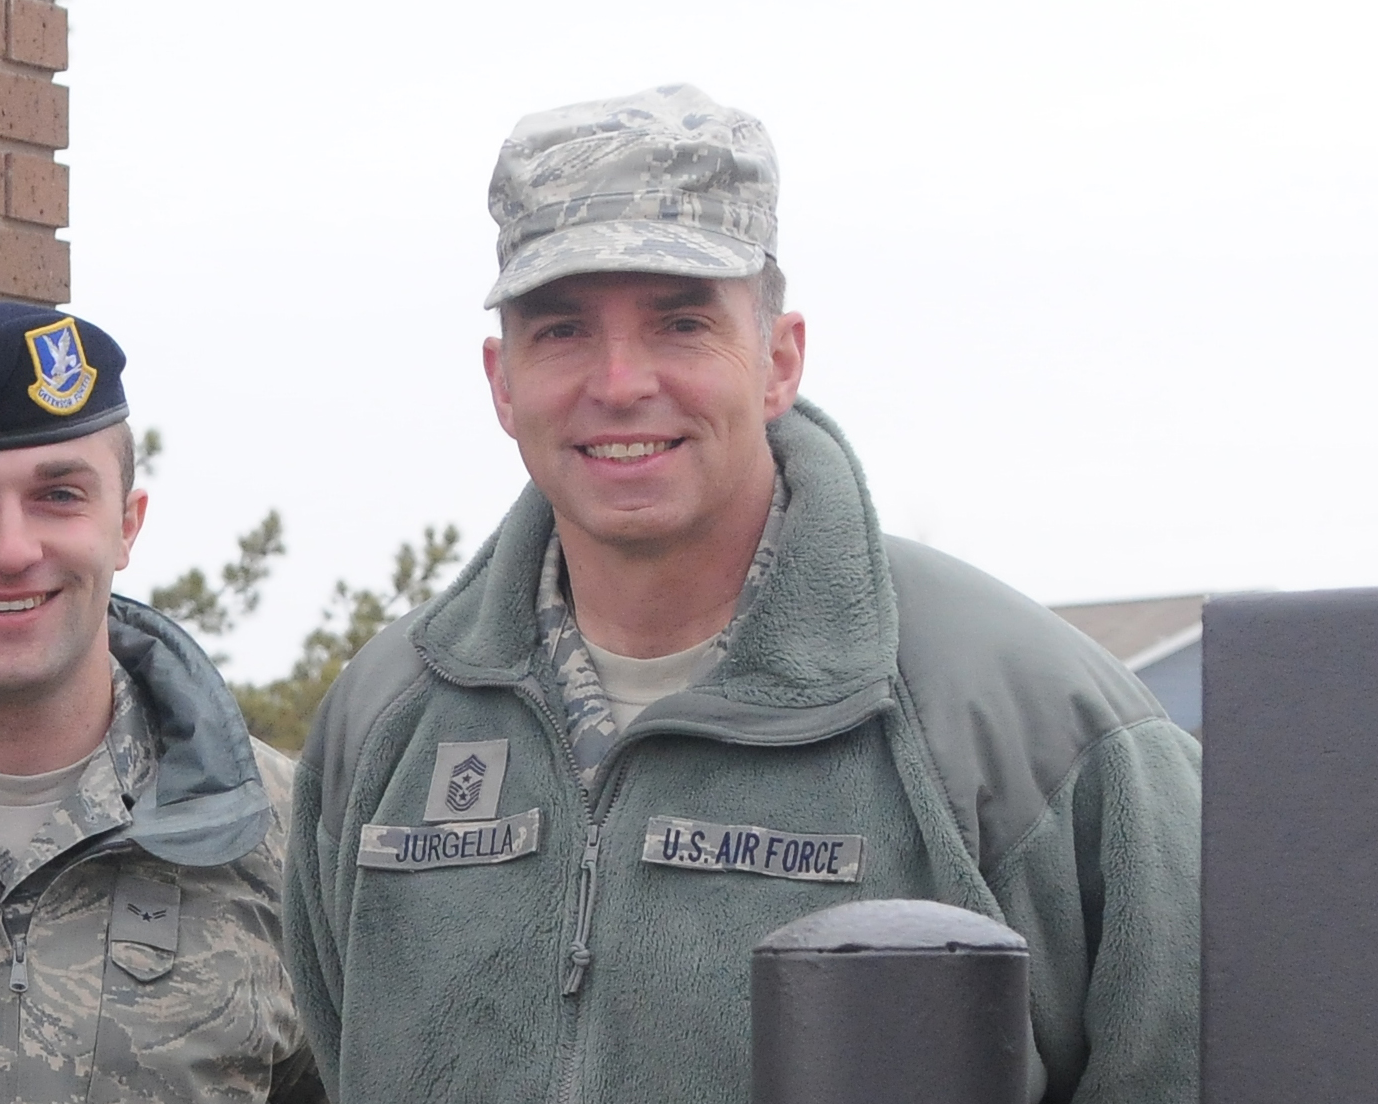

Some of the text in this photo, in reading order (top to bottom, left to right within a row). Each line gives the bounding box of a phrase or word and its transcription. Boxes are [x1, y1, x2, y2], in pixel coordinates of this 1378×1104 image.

[395, 823, 513, 863] JURGELLA
[662, 827, 844, 875] U.S. AIR FORCE
